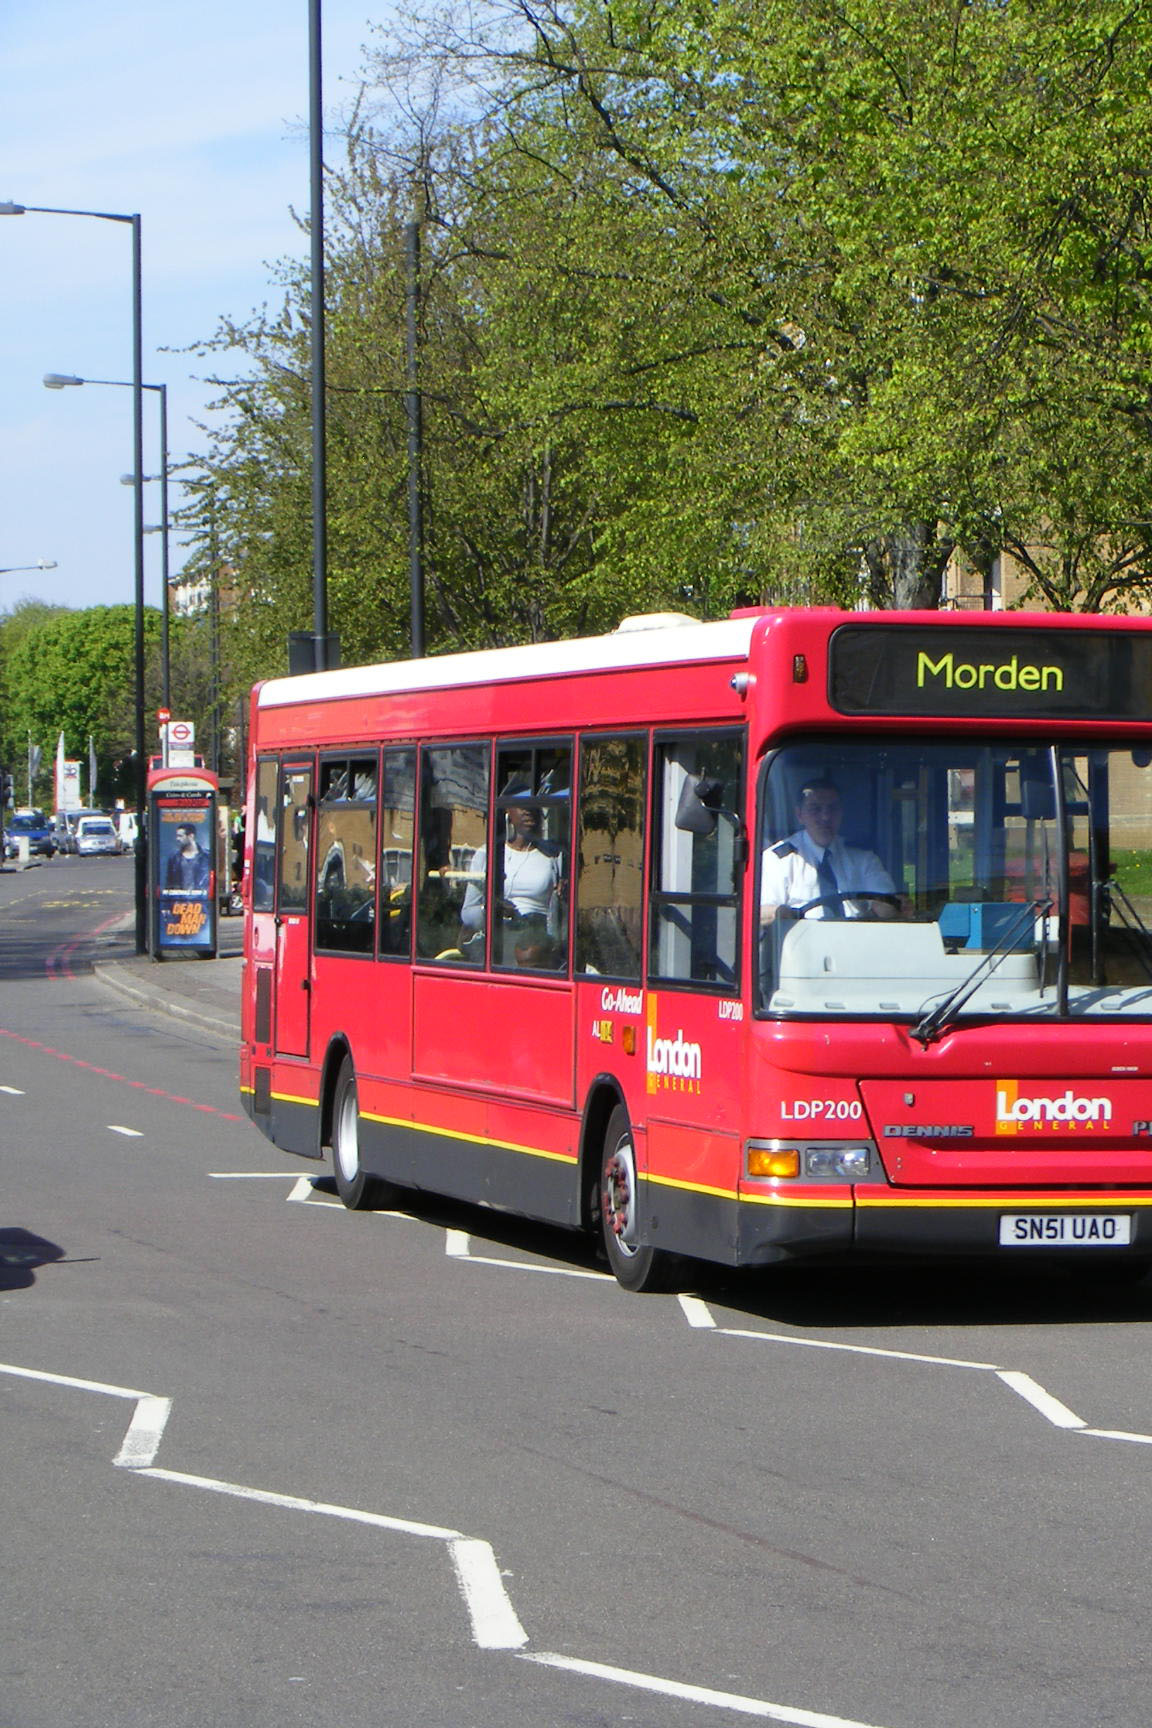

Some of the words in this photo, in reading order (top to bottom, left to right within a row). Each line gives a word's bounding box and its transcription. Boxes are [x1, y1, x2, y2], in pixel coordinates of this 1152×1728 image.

[917, 651, 1063, 691] Morden
[172, 902, 202, 915] DEAD
[180, 912, 207, 926] MAN
[167, 923, 200, 935] DOWN
[602, 987, 642, 1014] Go-Ahead
[718, 1000, 744, 1021] LDP200
[647, 1026, 702, 1079] London
[648, 1072, 701, 1095] GENERAL
[781, 1101, 862, 1120] LDP200
[997, 1090, 1112, 1121] London
[884, 1125, 974, 1138] DENNIS
[999, 1119, 1111, 1131] GENERAL
[1015, 1218, 1064, 1240] SN51
[1073, 1218, 1116, 1240] UAO
